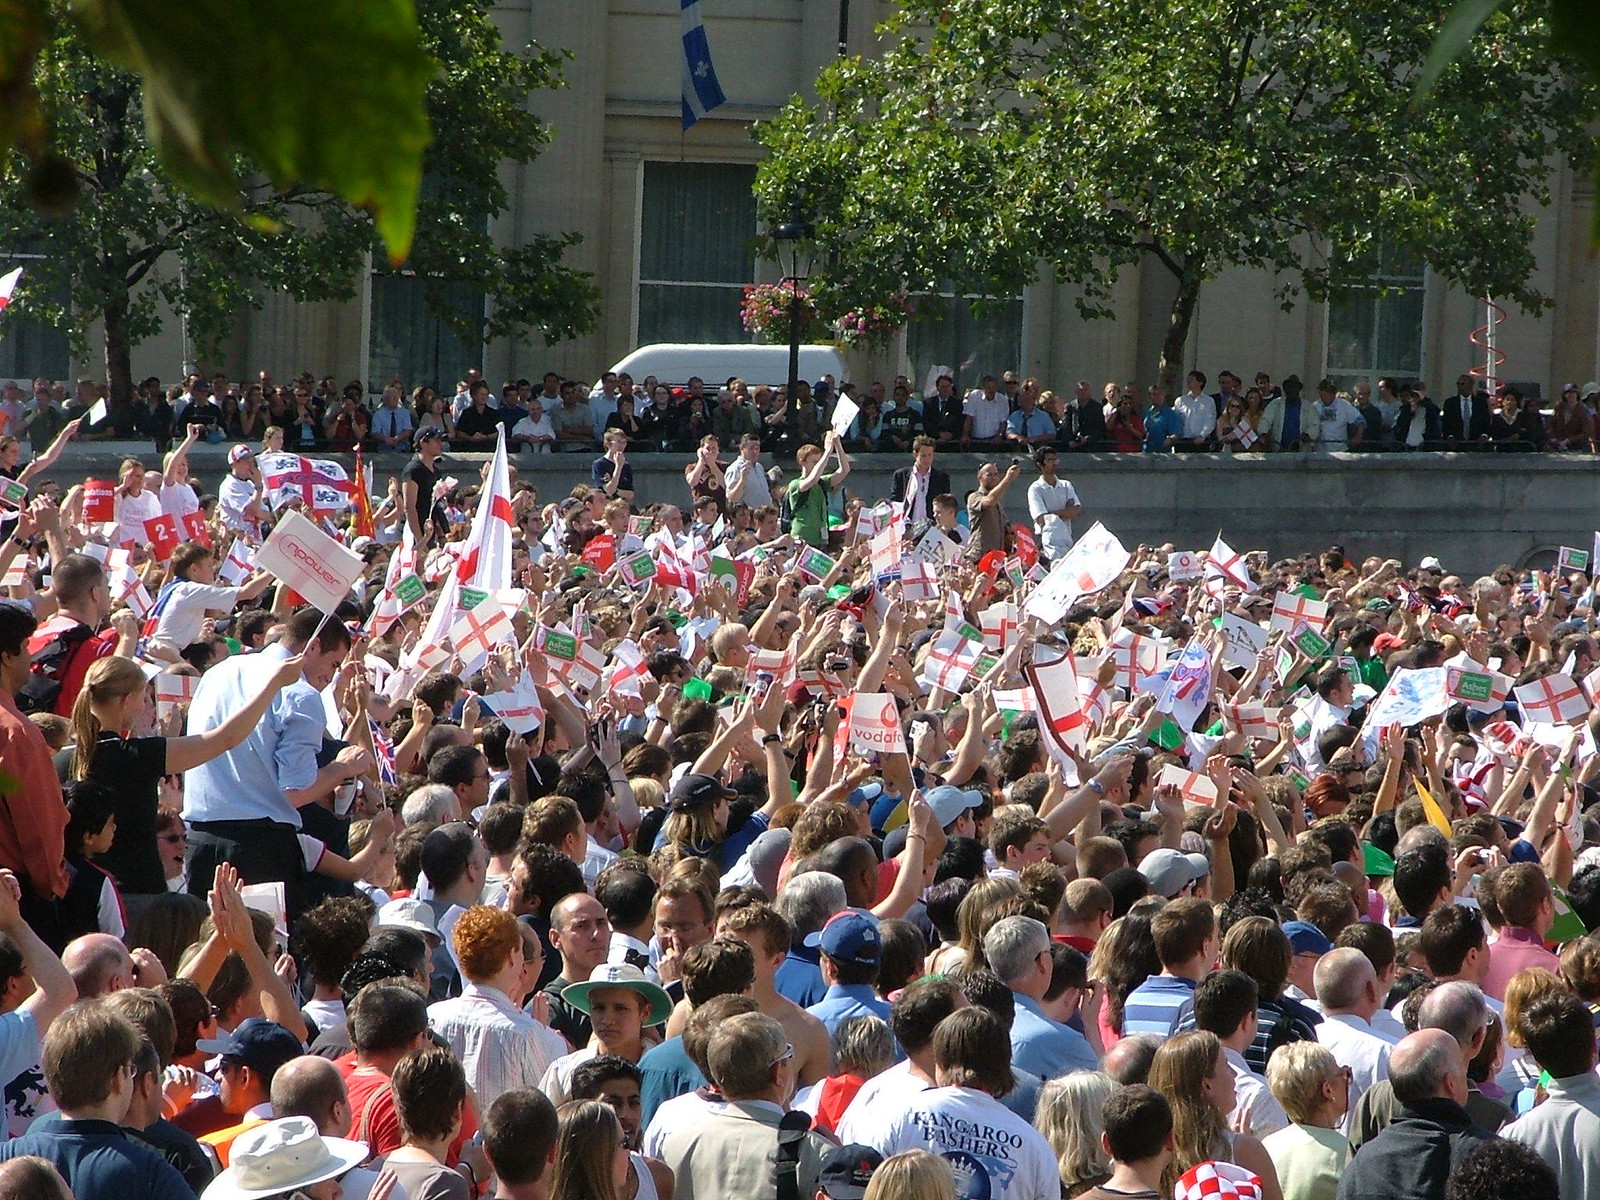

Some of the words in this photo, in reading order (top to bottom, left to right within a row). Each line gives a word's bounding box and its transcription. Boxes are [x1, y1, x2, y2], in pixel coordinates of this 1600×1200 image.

[287, 542, 341, 585] npower
[547, 640, 572, 654] Ashes
[1462, 681, 1487, 693] Ashes
[913, 1110, 1022, 1149] KANGAROO
[923, 1126, 1010, 1160] BASHERS
